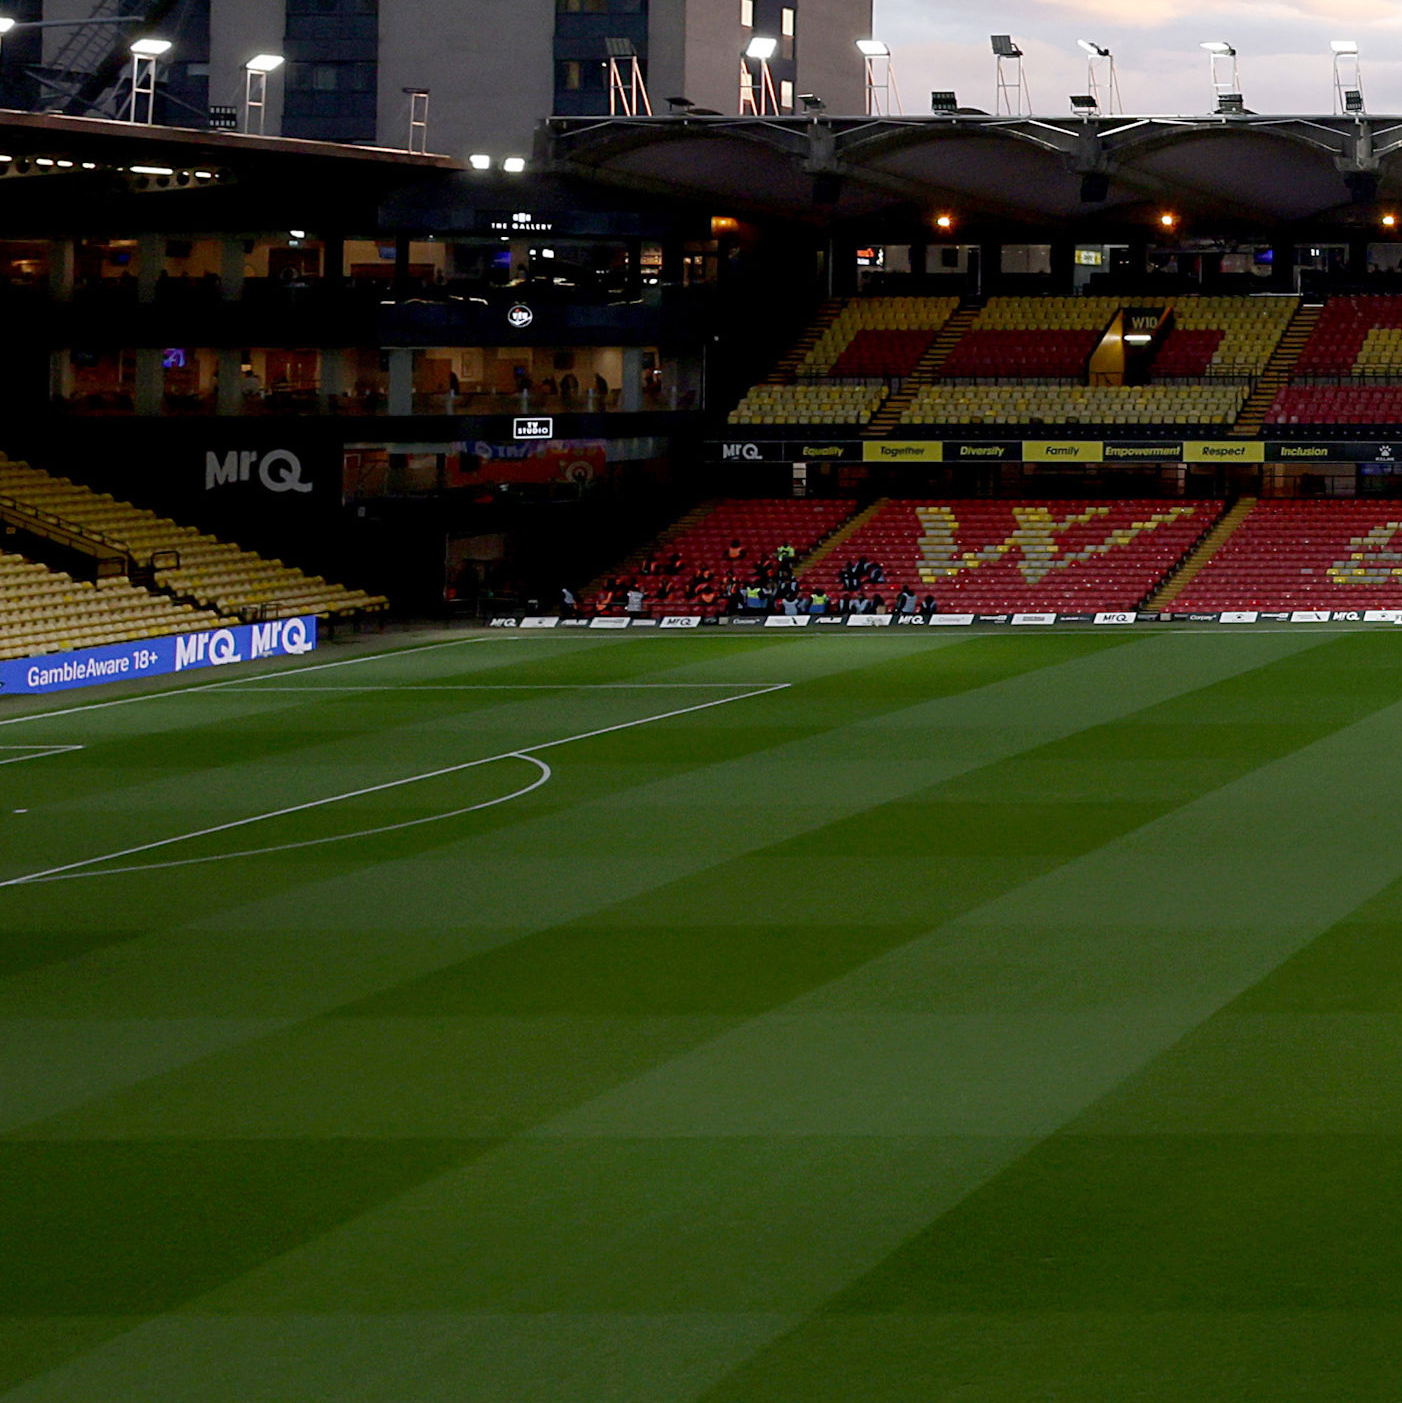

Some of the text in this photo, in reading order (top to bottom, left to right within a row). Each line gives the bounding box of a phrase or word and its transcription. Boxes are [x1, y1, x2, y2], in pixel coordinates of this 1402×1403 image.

[1131, 316, 1158, 329] W10
[722, 442, 764, 461] MrQ
[802, 445, 846, 458] Equality
[880, 446, 925, 458] Together
[959, 445, 1006, 458] Diversity
[1045, 445, 1080, 457] Family
[1104, 445, 1181, 458] Empowerment
[1201, 446, 1246, 458] Respect
[1280, 446, 1329, 457] Inclusion
[204, 448, 314, 494] MrQ
[250, 617, 313, 660] MrQ
[175, 628, 242, 672] MrQ
[27, 649, 159, 688] GambleAware 18+
